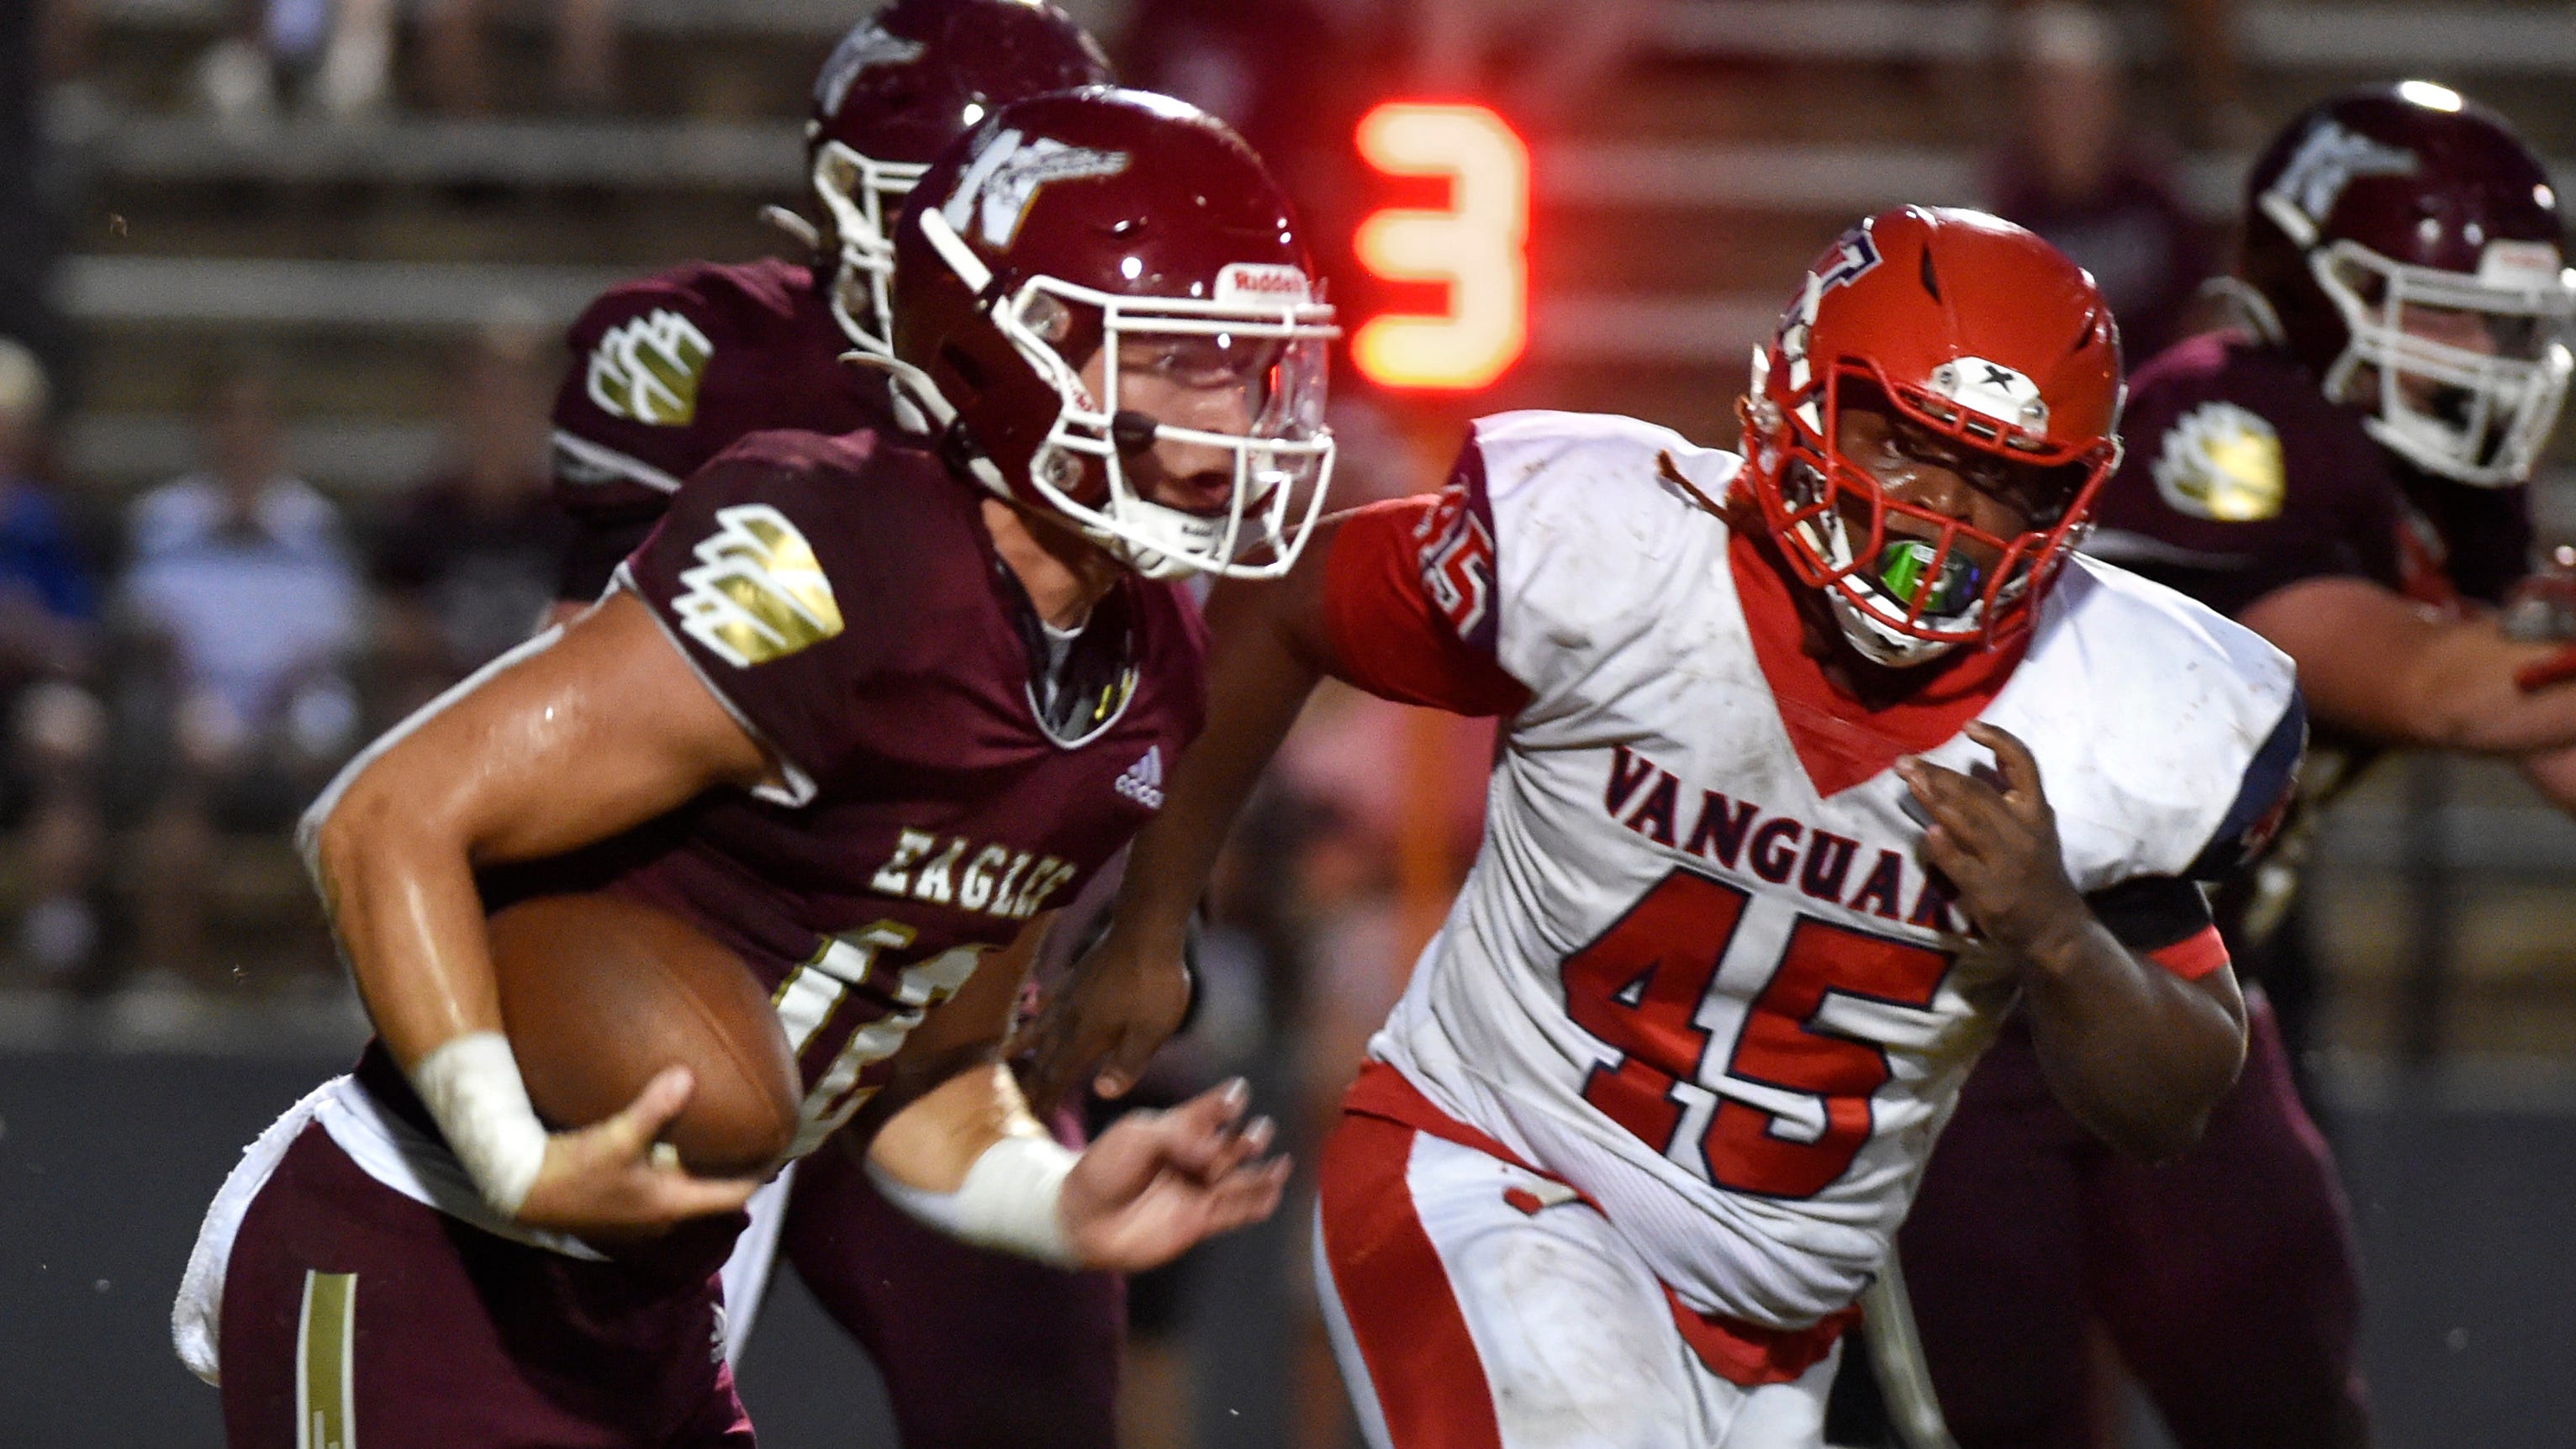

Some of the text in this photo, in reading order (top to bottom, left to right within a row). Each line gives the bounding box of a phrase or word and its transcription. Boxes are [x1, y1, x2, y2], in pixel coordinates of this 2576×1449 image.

[1352, 101, 1530, 390] 3
[1604, 745, 1987, 940] VANGUAR
[1560, 866, 1954, 1200] 45
